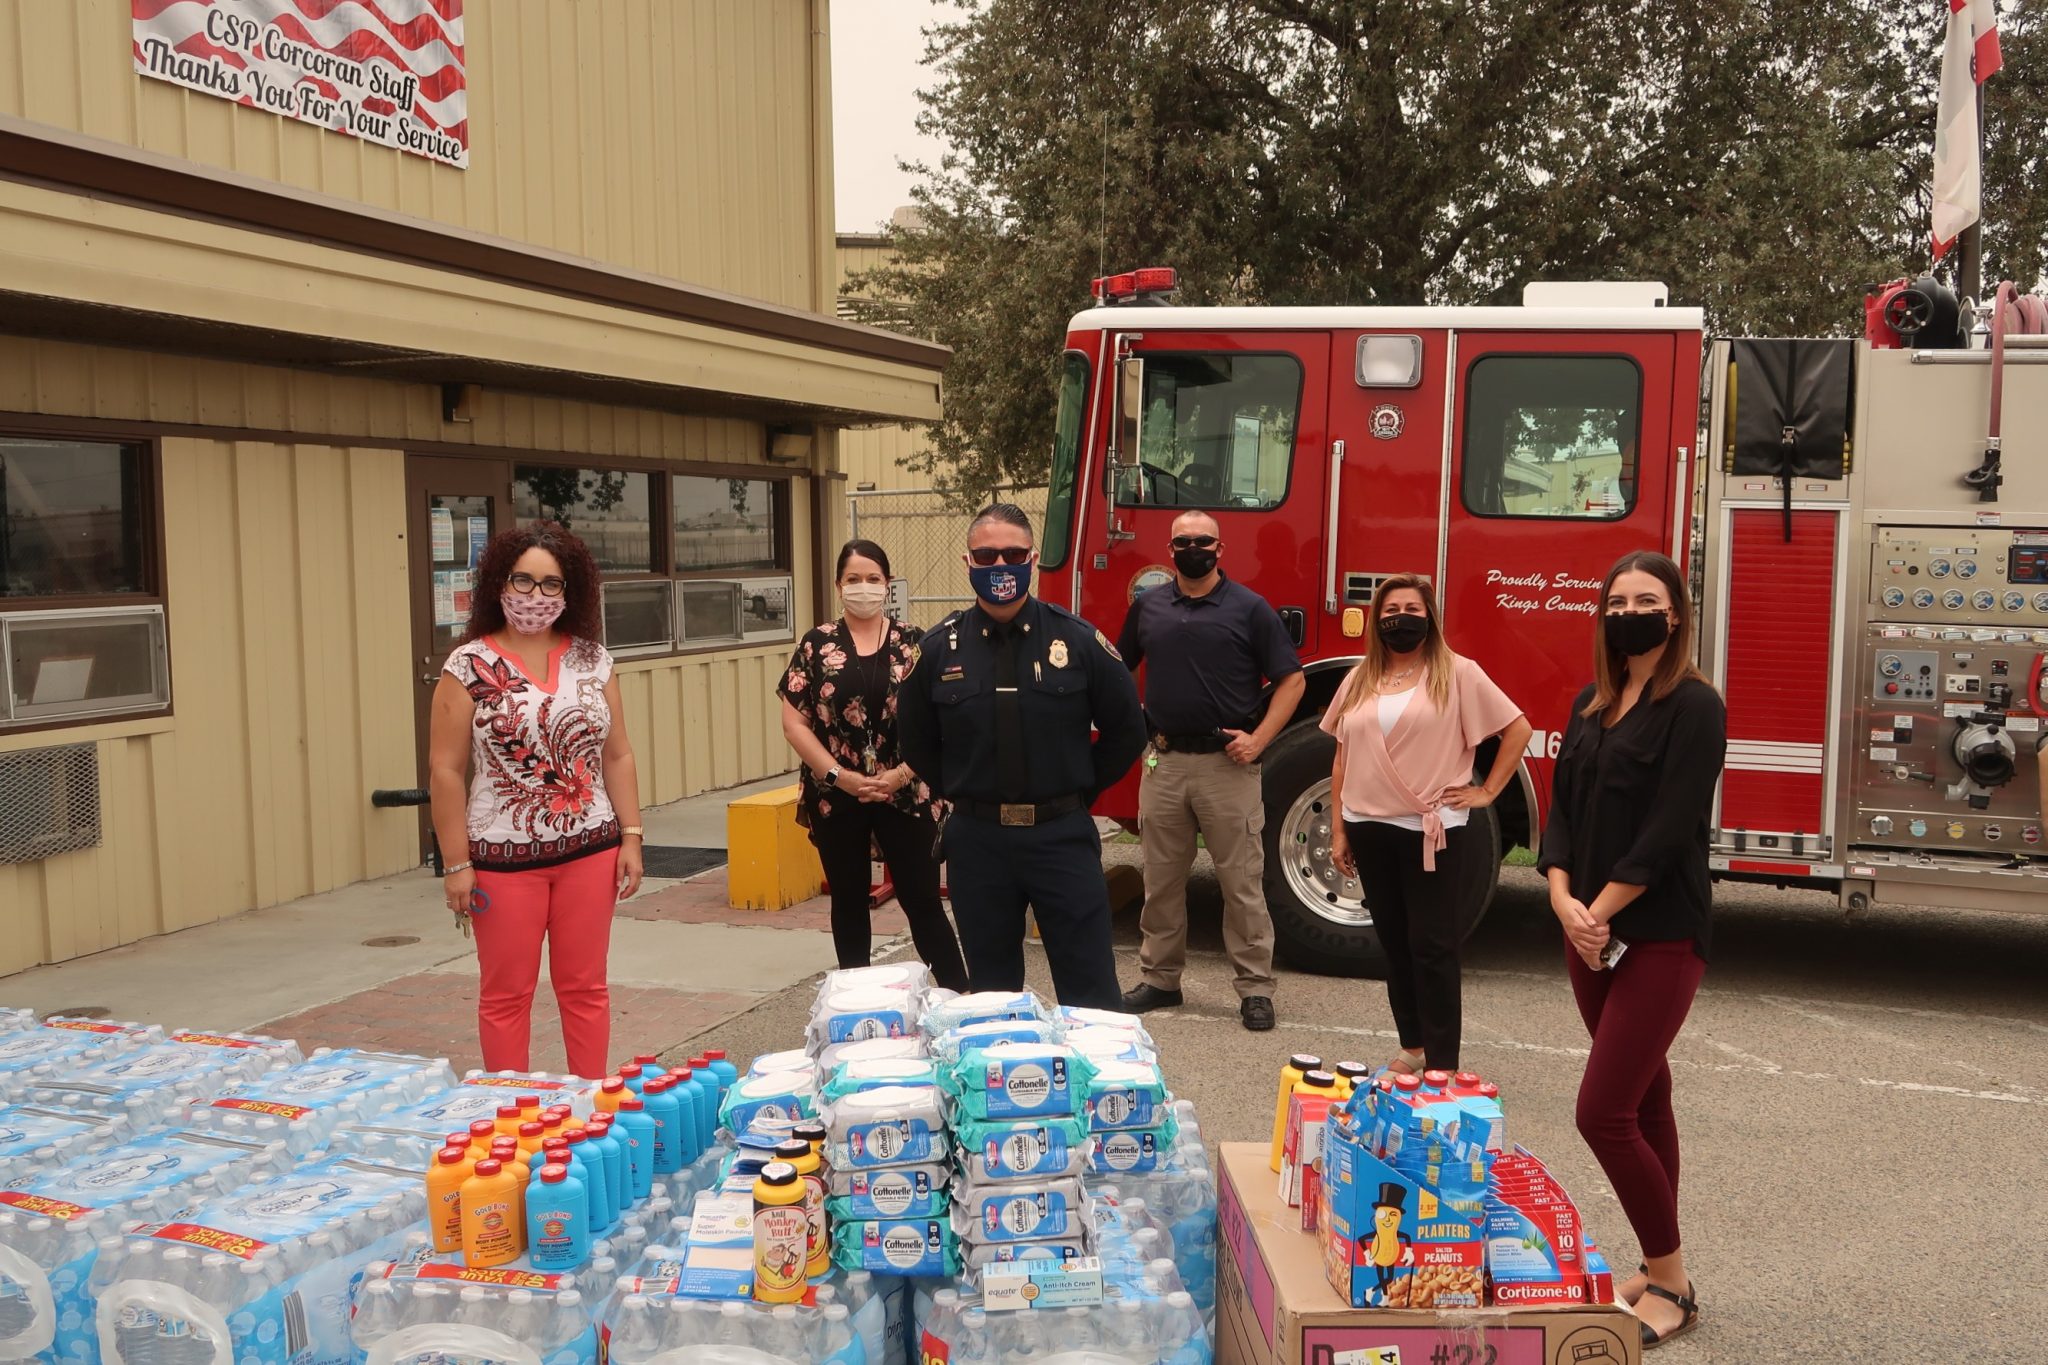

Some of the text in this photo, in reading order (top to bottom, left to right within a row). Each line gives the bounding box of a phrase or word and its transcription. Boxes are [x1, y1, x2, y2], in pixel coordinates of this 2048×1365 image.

[207, 9, 417, 112] CSP Corcoran Staff
[144, 39, 461, 161] Thanks You For Your Service
[1486, 569, 1603, 591] Proudly Servin
[1495, 594, 1599, 616] Kings County
[1547, 731, 1562, 759] 6
[1008, 1079, 1049, 1090] Cottonelle
[879, 1128, 888, 1158] Cottonelle
[1016, 1135, 1024, 1171] Cottonelle
[1106, 1146, 1138, 1154] Cottonelle
[873, 1187, 911, 1196] Cottonelle
[475, 1206, 492, 1216] GOLD
[554, 1211, 572, 1219] BOND
[764, 1217, 797, 1229] Monkey
[771, 1226, 792, 1238] Butt
[1417, 1224, 1470, 1239] PLANTERS
[181, 1233, 215, 1247] VALUE
[885, 1240, 923, 1249] Cottonelle
[1558, 1235, 1574, 1248] 10
[1424, 1253, 1463, 1263] PEANUTS
[458, 1271, 503, 1283] VALUE
[988, 1288, 1018, 1297] equate
